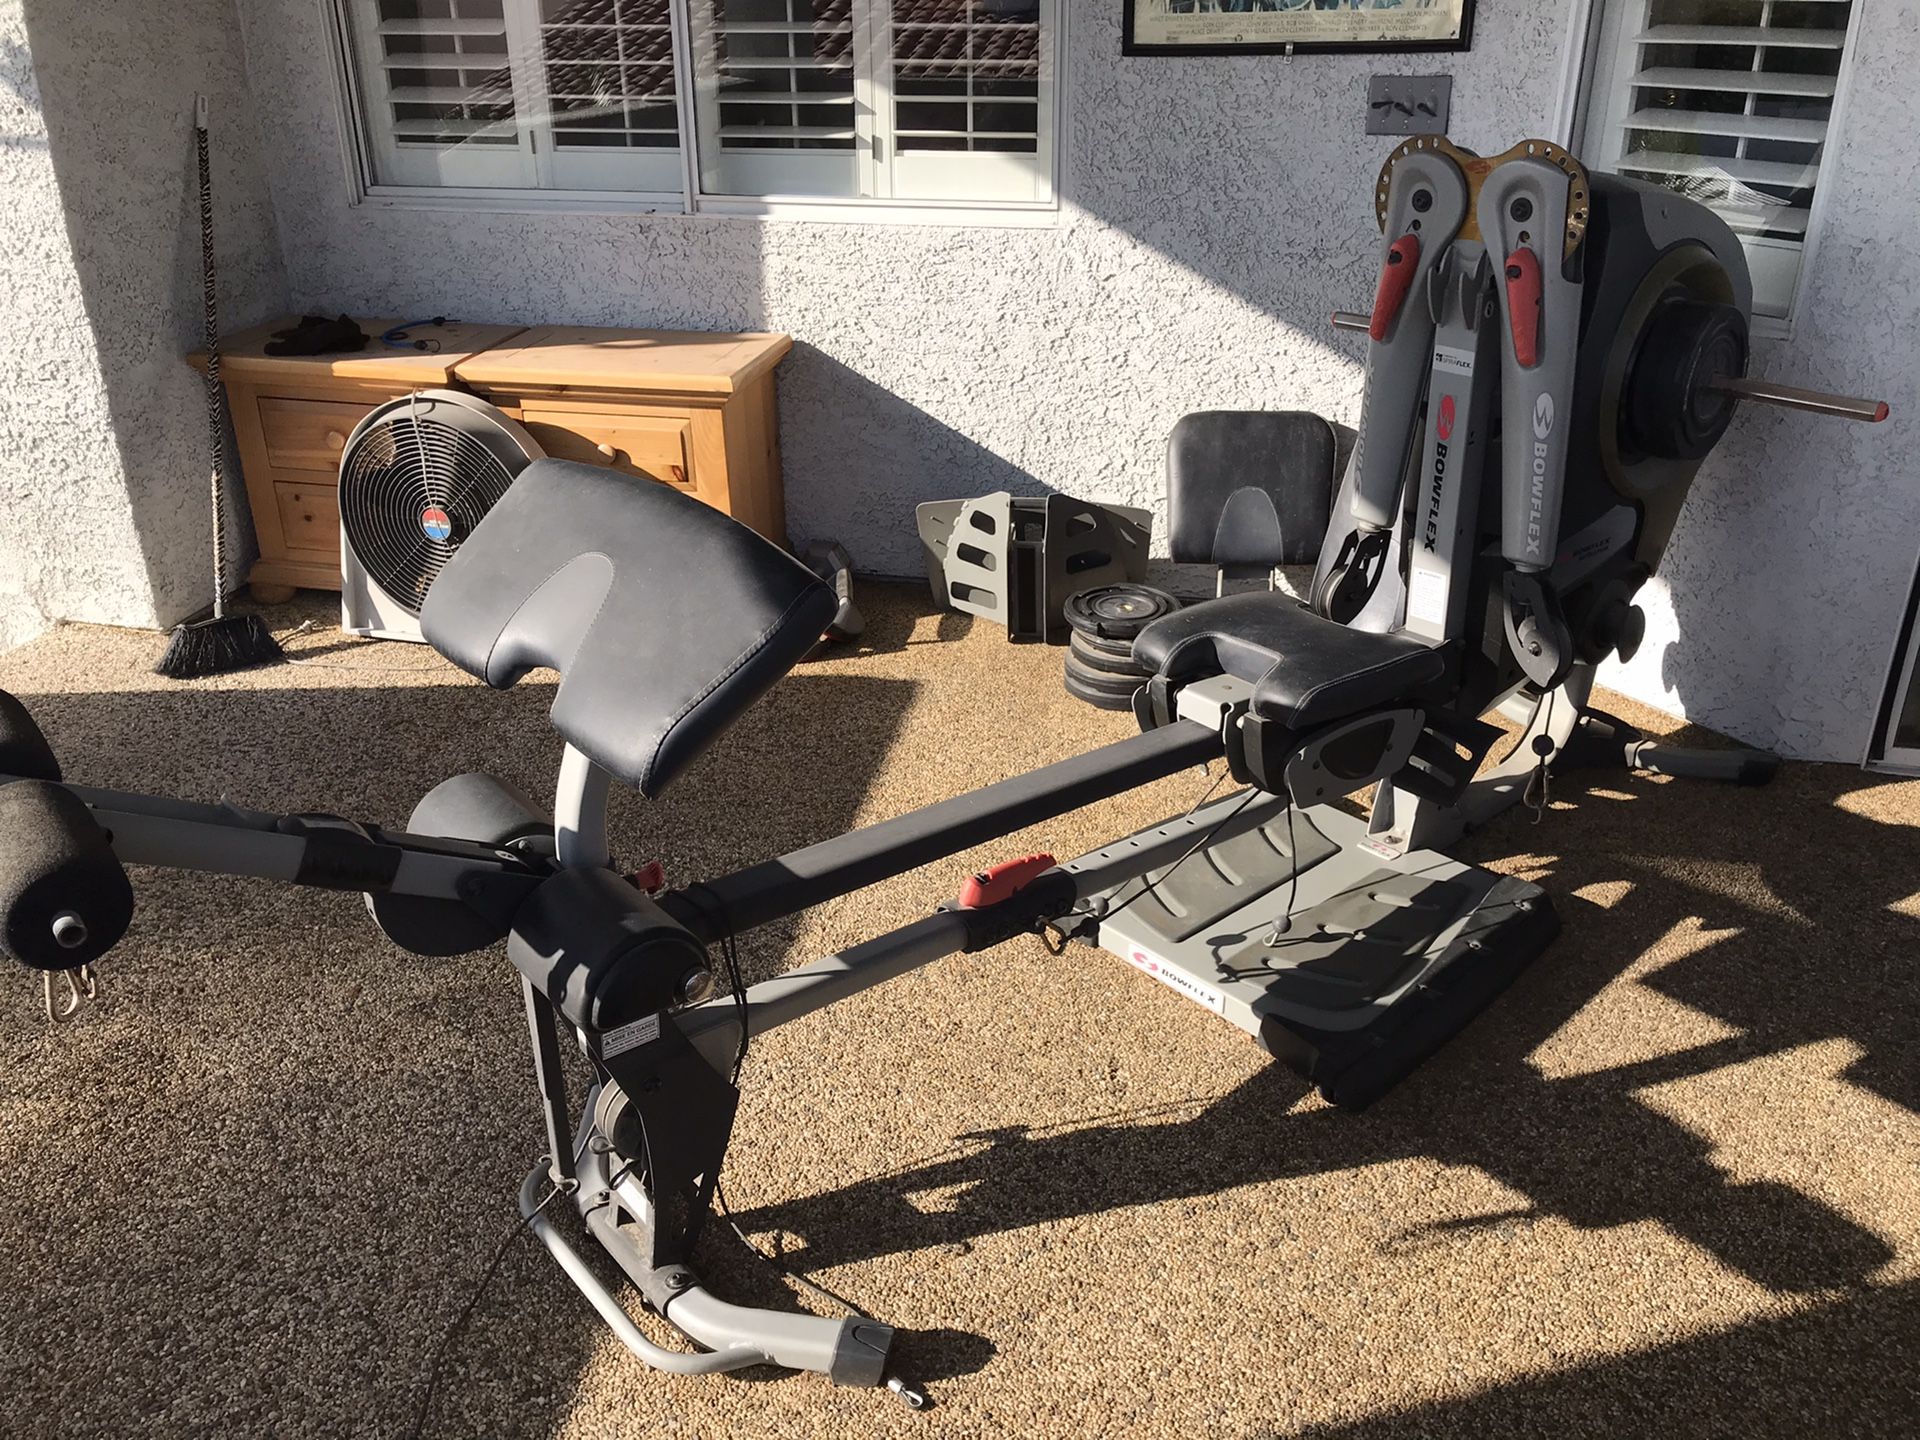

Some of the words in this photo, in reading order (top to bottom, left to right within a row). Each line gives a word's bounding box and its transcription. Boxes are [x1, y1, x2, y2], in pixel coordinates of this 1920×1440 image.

[1424, 442, 1448, 553] BOWFLEX
[1526, 441, 1548, 555] BOWFLEX
[1161, 968, 1216, 1005] BOWFLEX
